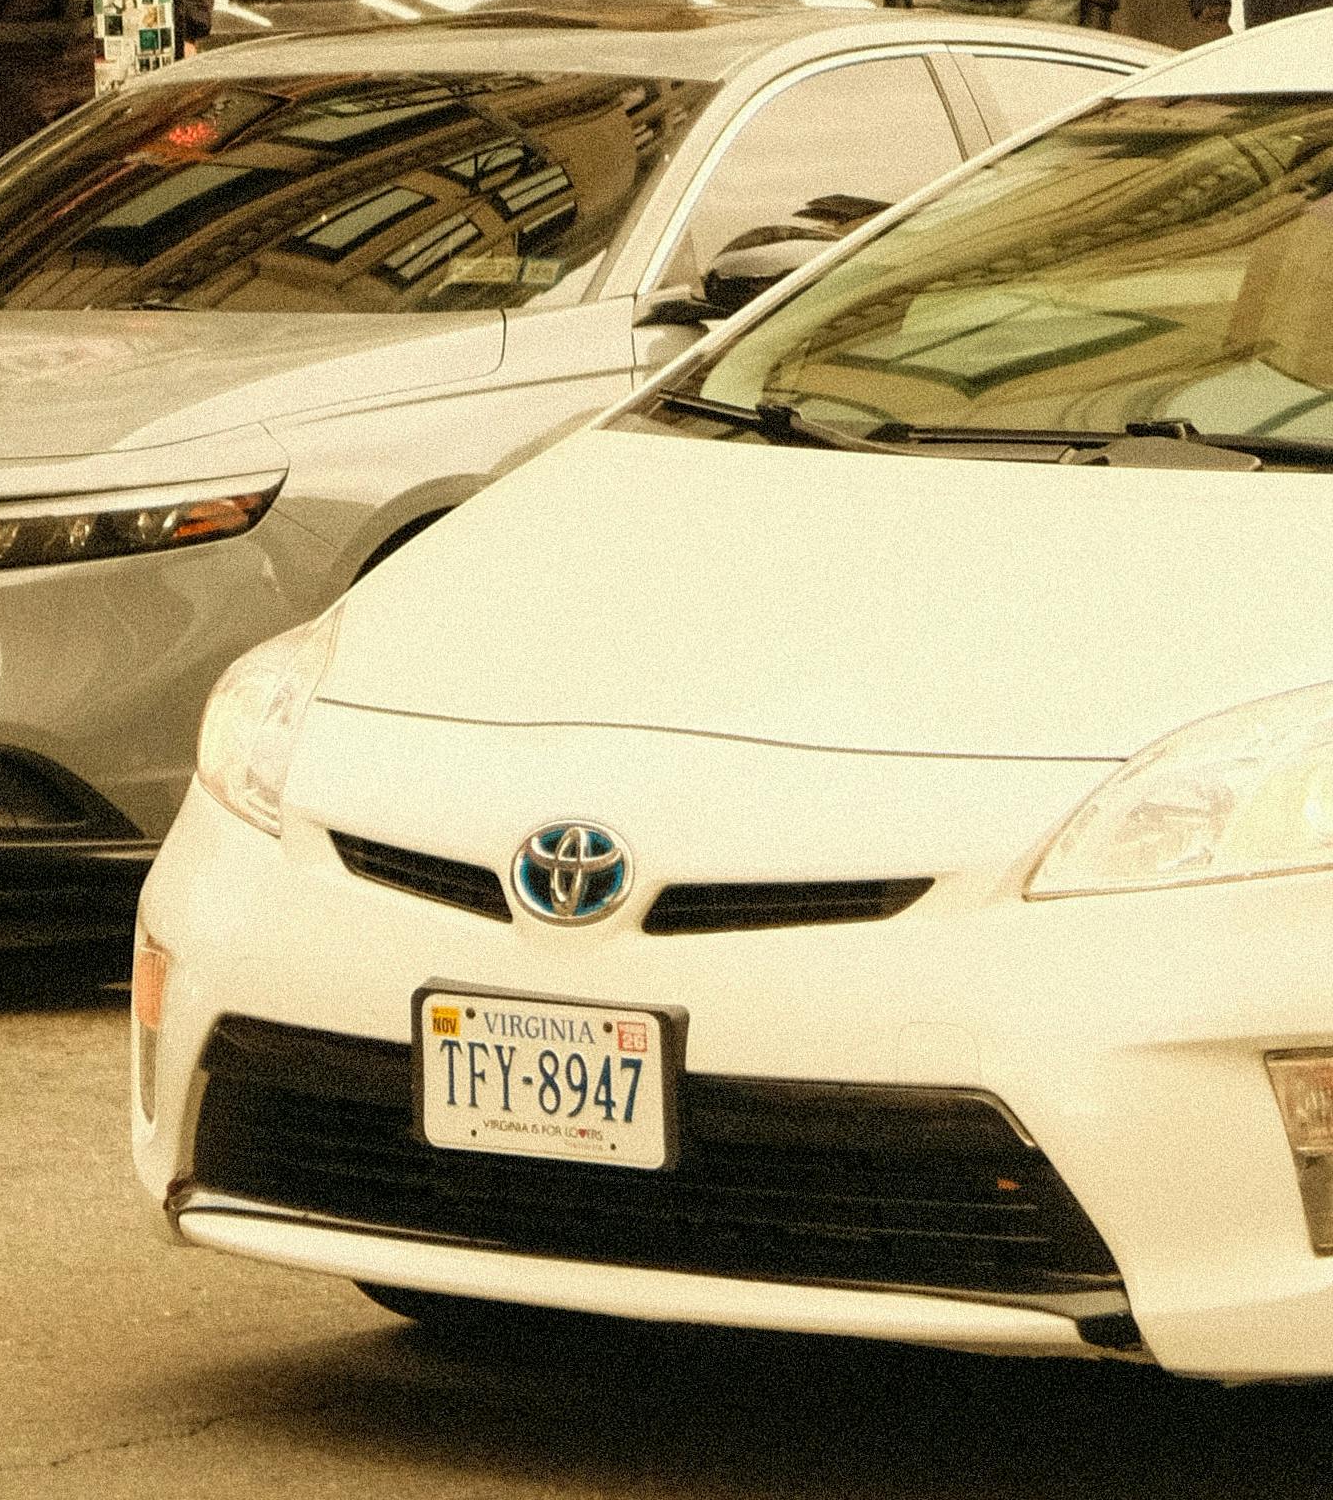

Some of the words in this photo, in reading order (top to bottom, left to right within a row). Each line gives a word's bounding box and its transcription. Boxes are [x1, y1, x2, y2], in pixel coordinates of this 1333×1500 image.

[433, 1017, 458, 1034] NOV
[483, 1012, 596, 1045] VIRGINIA
[440, 1039, 644, 1124] TFY-8947
[541, 1125, 562, 1136] FOR
